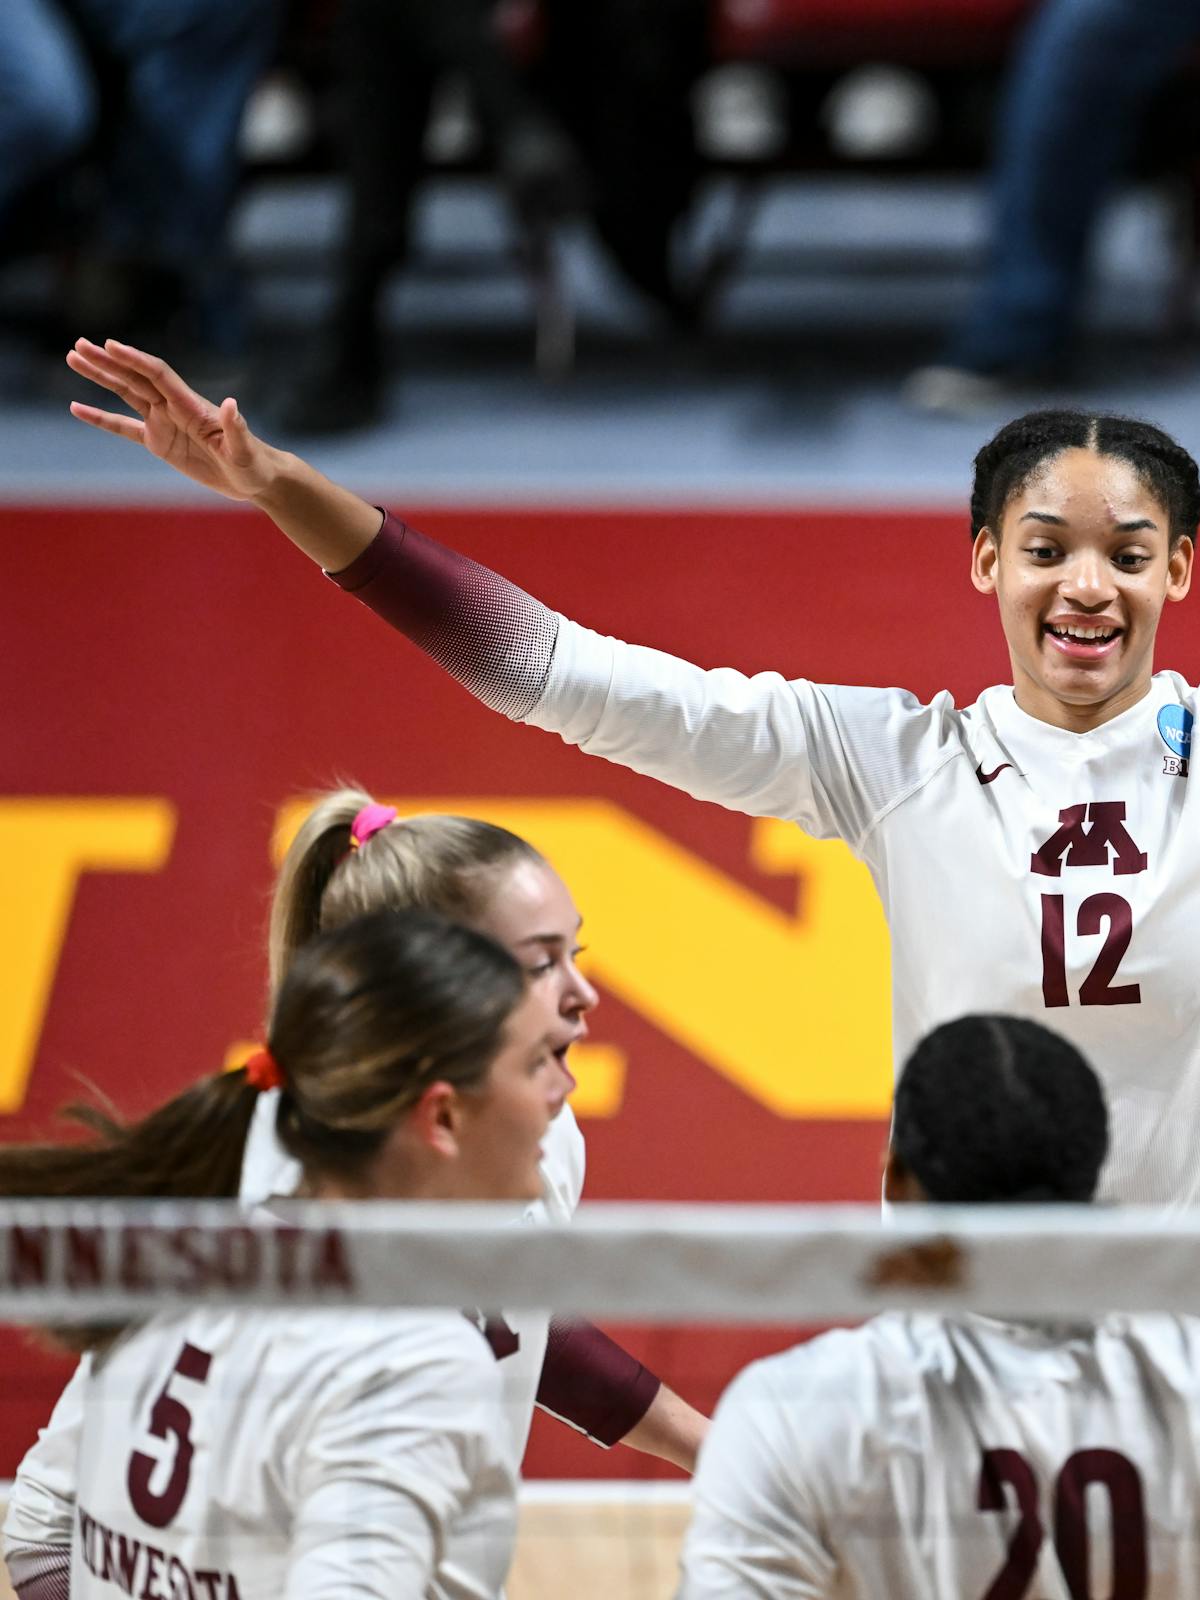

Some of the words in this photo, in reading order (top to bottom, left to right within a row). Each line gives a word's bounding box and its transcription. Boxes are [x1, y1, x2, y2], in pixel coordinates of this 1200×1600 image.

[1040, 892, 1141, 1008] 12
[127, 1342, 213, 1528] 5
[977, 1448, 1150, 1600] 20
